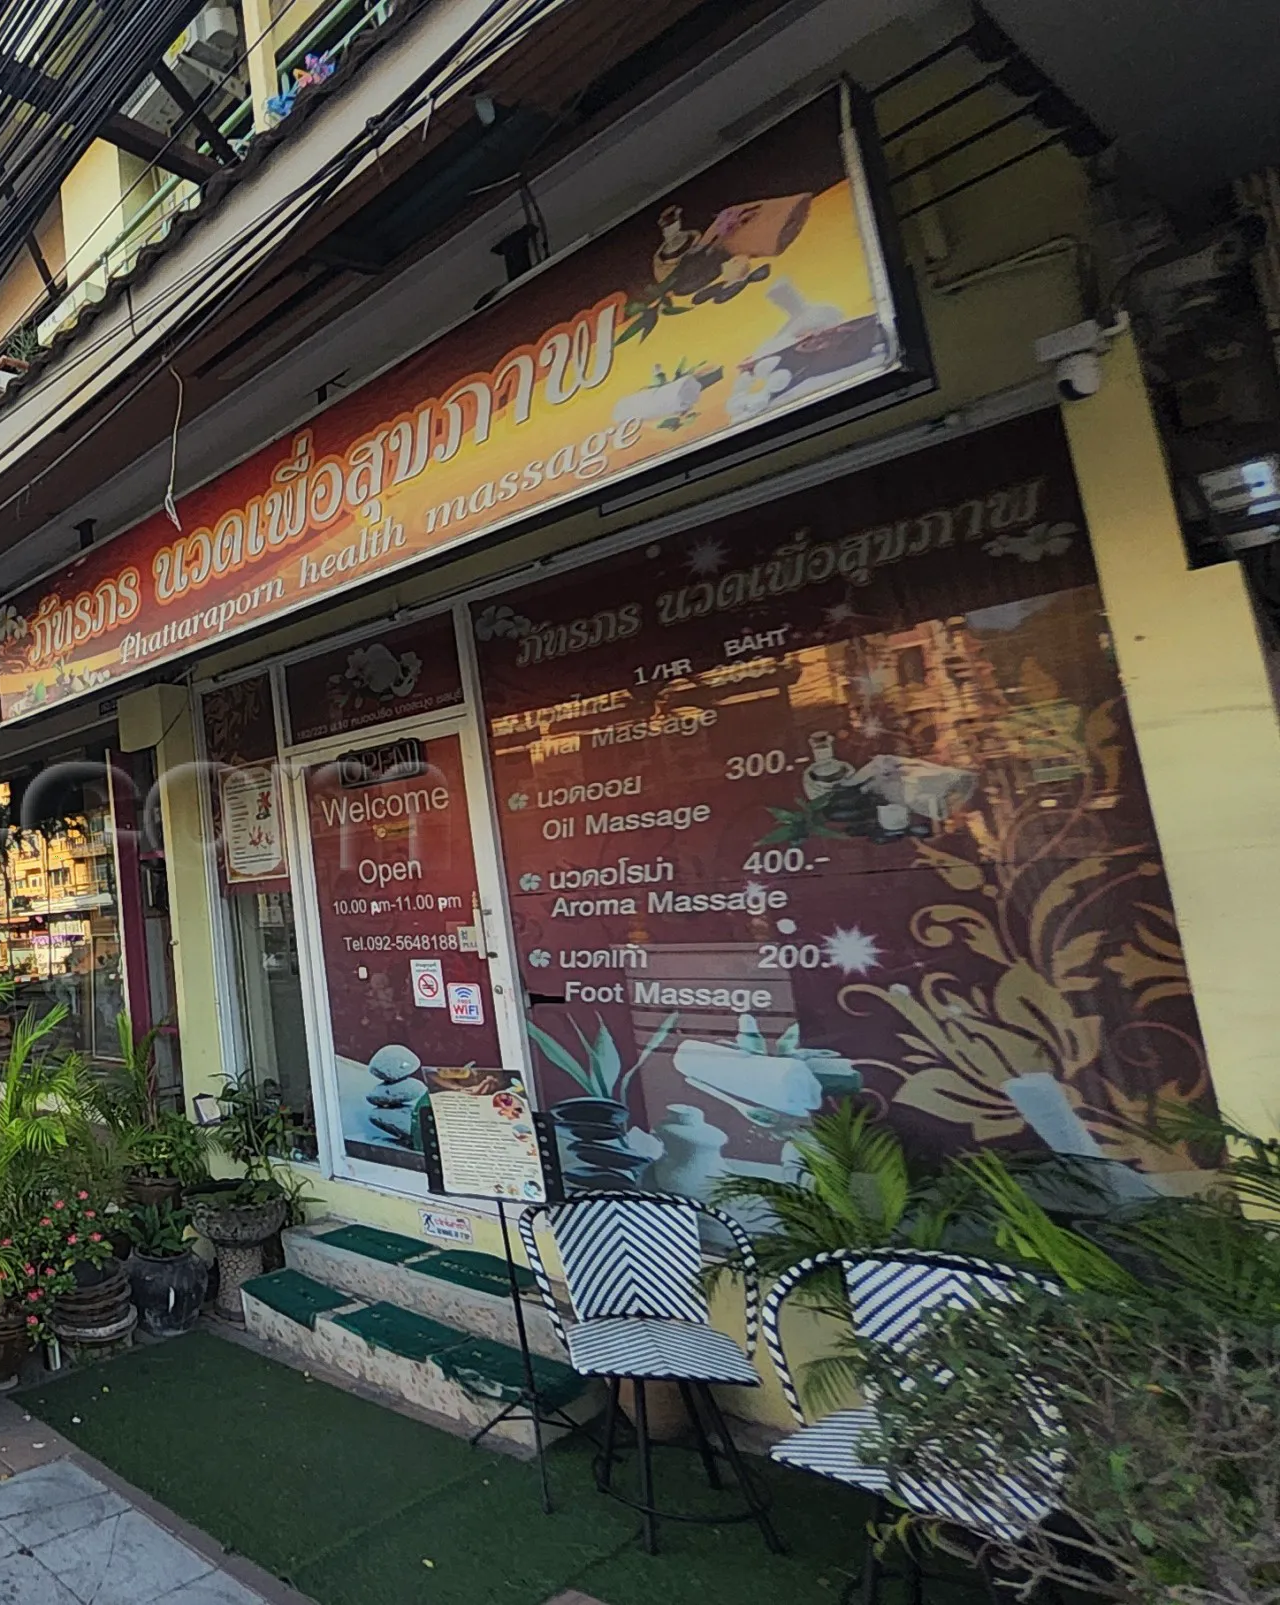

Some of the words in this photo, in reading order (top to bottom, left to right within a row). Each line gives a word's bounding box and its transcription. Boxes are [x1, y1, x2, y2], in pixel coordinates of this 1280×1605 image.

[154, 302, 618, 600] นวดเพื่อสุขภาพ
[119, 576, 285, 664] Phattaraporn
[298, 515, 408, 589] health
[424, 415, 643, 534] massage
[655, 476, 1045, 628] นวดเพื่อสุขภาพ
[723, 627, 789, 658] BAHT
[590, 708, 718, 749] Massage
[341, 742, 415, 785] OPEN
[320, 785, 450, 828] Welcome
[537, 775, 642, 809] นวดออย
[542, 816, 575, 841] Oil
[584, 803, 711, 836] Massage
[358, 858, 423, 889] Open
[549, 856, 674, 890] นวดอโรม่า
[742, 847, 831, 875] 400.-
[333, 898, 367, 915] 10.00
[550, 896, 637, 918] Aroma
[647, 889, 788, 917] Massage
[559, 943, 648, 970] นวดเท้า
[564, 980, 625, 1004] Foot
[633, 981, 773, 1013] Massage
